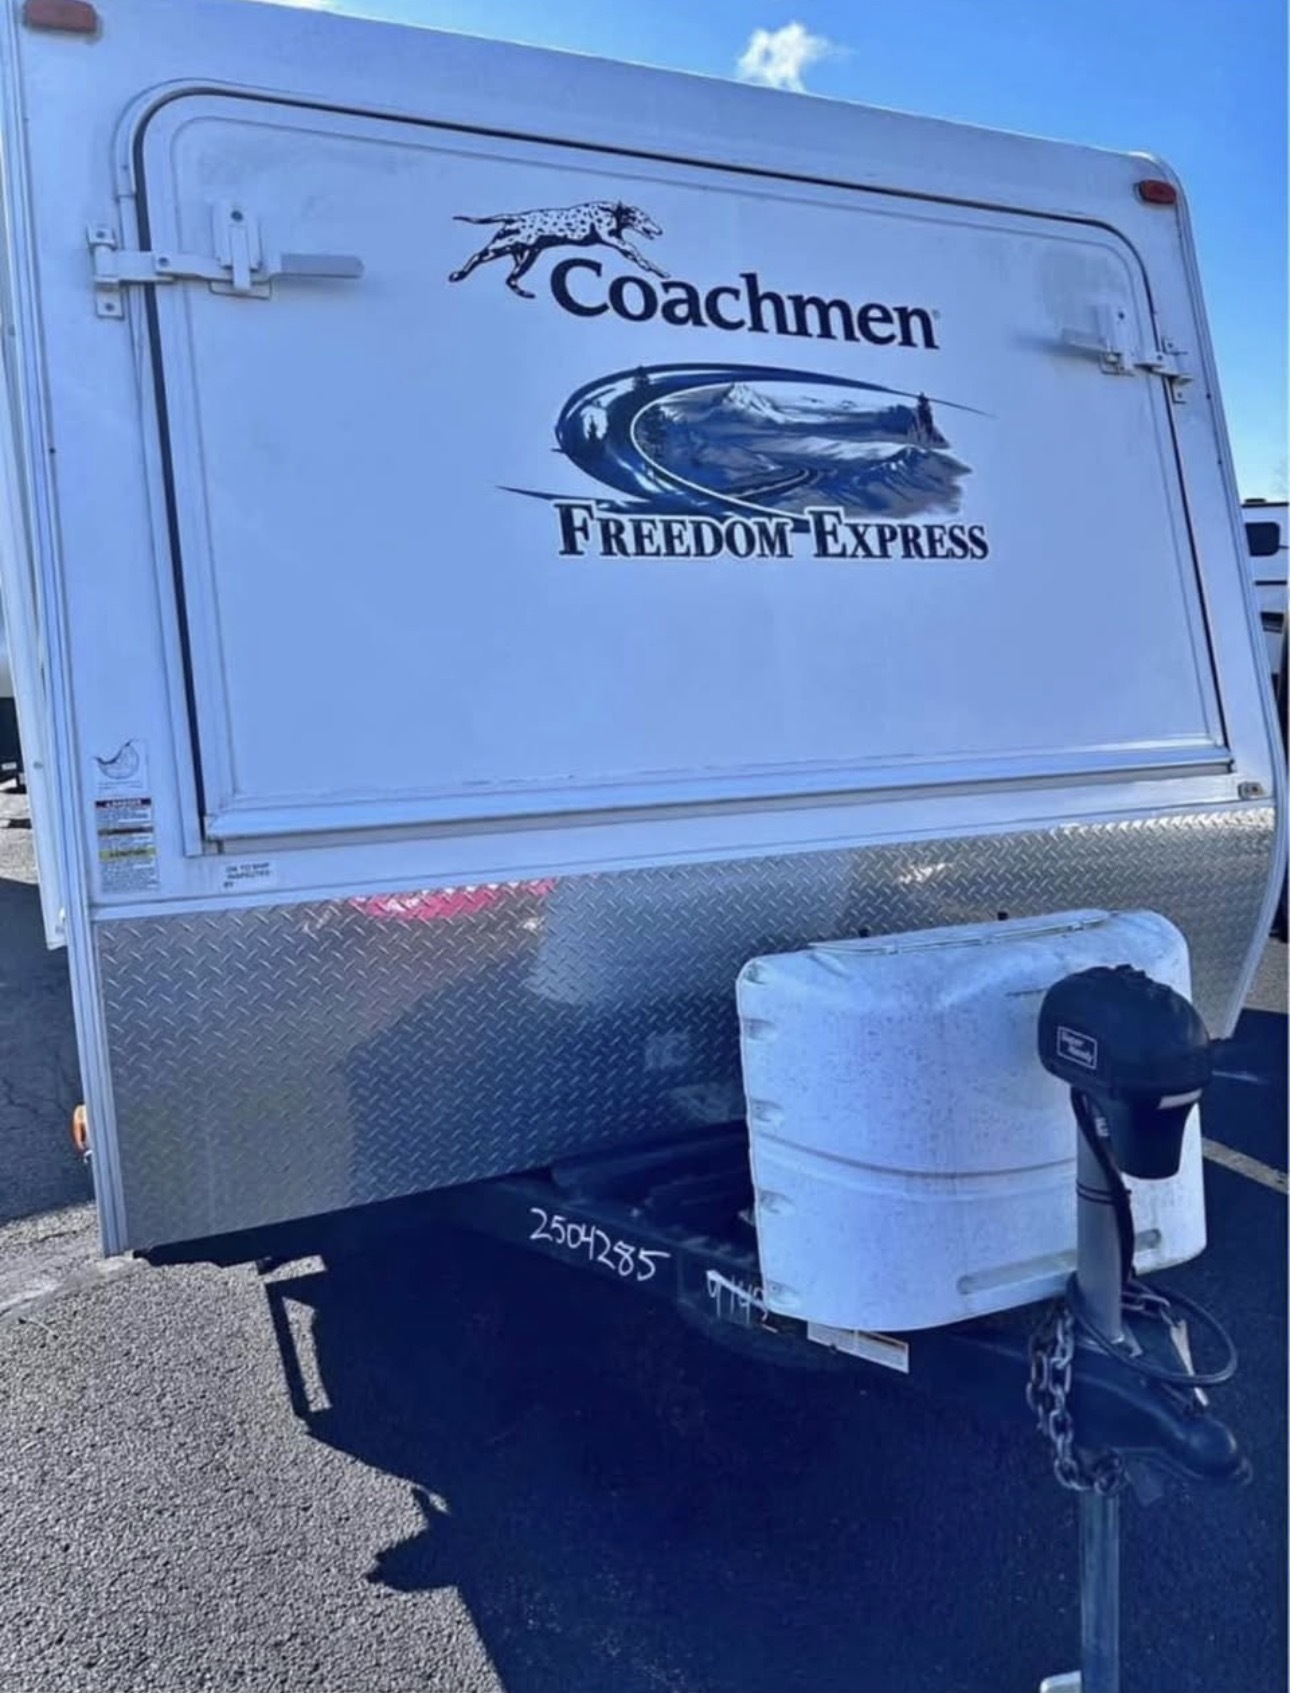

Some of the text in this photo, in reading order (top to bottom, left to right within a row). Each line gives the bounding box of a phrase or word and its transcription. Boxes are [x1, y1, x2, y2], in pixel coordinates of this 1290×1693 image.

[550, 257, 940, 350] Coachmen
[556, 502, 989, 560] FREEDOM EXPRESS
[529, 1208, 671, 1281] 2504285
